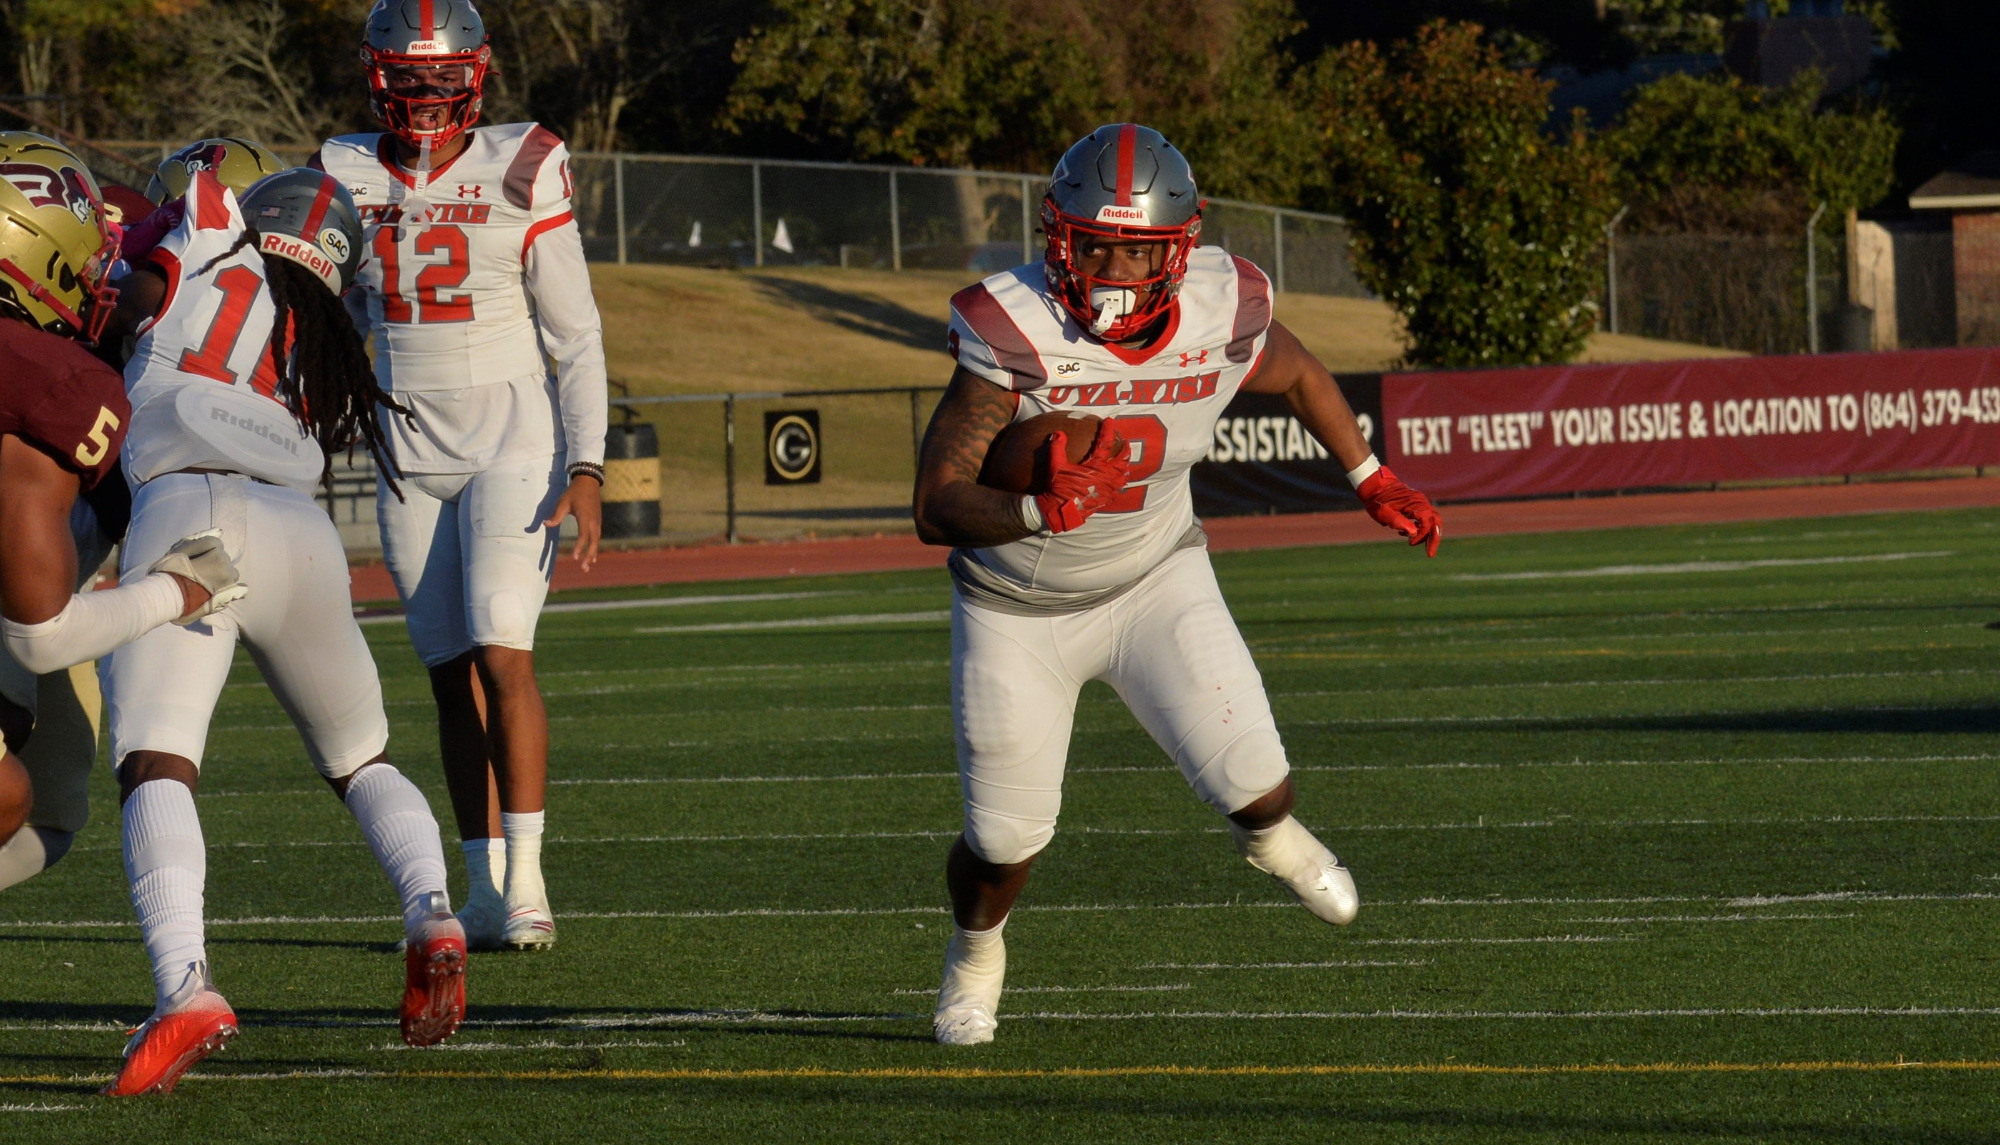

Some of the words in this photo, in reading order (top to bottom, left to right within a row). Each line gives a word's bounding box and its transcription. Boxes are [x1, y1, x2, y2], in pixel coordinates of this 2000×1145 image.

[411, 42, 445, 51] Ridde
[1103, 208, 1144, 219] Riddell
[263, 235, 334, 279] Riddell
[326, 232, 348, 258] SAC
[373, 224, 476, 324] 12
[1047, 370, 1221, 406] UVA-WISE
[1057, 362, 1081, 375] SAC
[76, 405, 120, 466] 5
[211, 406, 299, 458] Riddell
[1397, 416, 1452, 456] TEXT
[1457, 411, 1545, 453] "FLEET"
[1550, 407, 1616, 447] YOUR
[1619, 403, 1683, 443] ISSUE
[1688, 400, 1709, 438] &
[1713, 396, 1823, 437] LOCATION
[1826, 393, 1860, 432] TO
[1863, 388, 1918, 437] (864)
[775, 426, 811, 469] G
